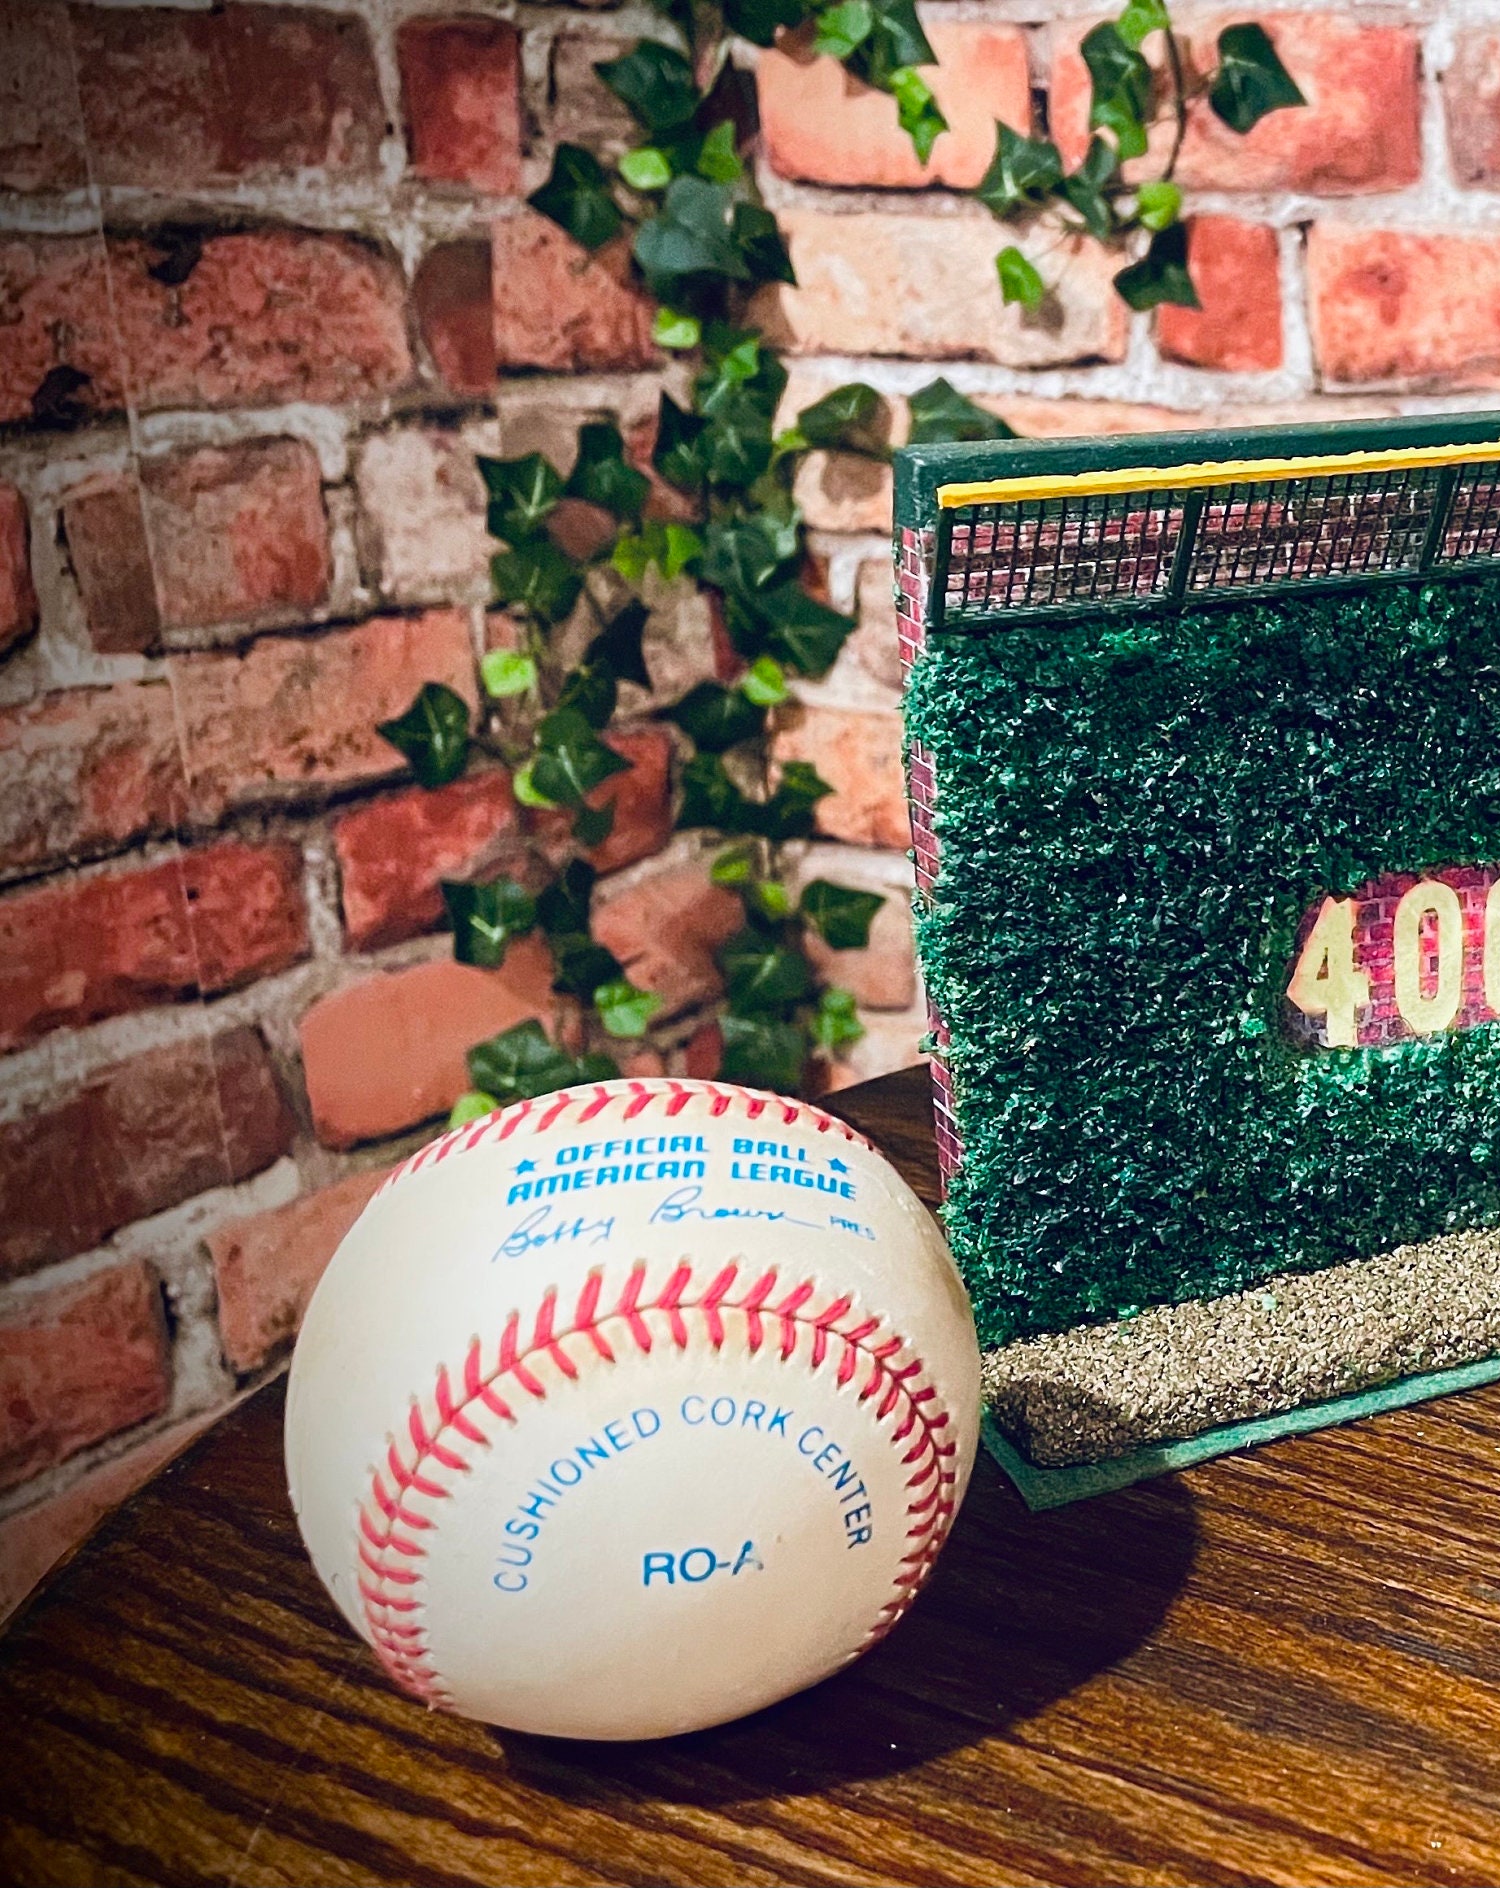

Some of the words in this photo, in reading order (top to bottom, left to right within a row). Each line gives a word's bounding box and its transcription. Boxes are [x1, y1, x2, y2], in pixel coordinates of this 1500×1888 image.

[556, 1135, 710, 1166] OFFICIAL
[732, 1138, 809, 1163] BALL
[507, 1160, 705, 1206] AMERICAN
[731, 1161, 857, 1200] LEAGUE
[649, 1185, 826, 1229] Brown
[493, 1407, 661, 1592] CUSHIONED
[680, 1394, 795, 1438] CORK
[798, 1425, 873, 1549] CENTER
[643, 1540, 764, 1587] RO-A
